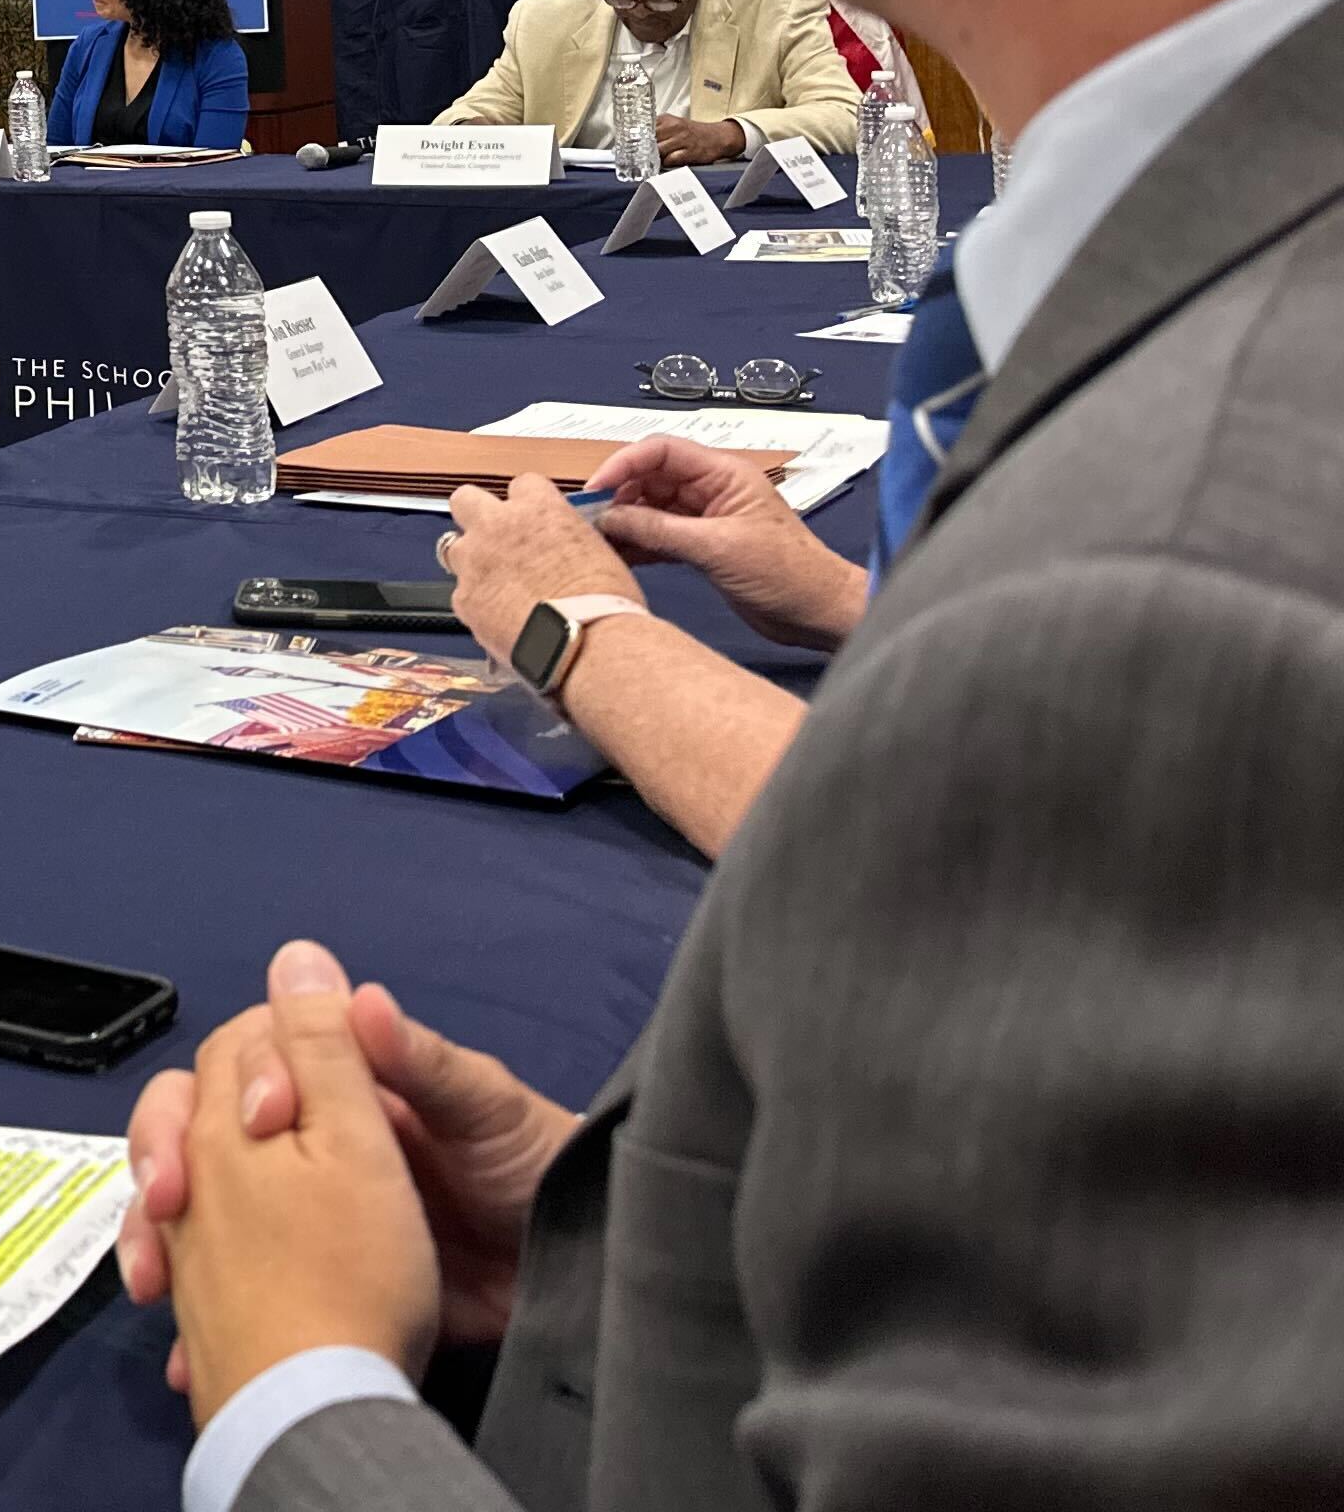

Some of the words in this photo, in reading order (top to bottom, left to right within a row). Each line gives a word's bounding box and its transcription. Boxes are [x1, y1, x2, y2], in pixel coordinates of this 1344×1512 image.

[420, 139, 465, 152] Dwight
[467, 139, 506, 151] Evans
[12, 357, 66, 378] THE
